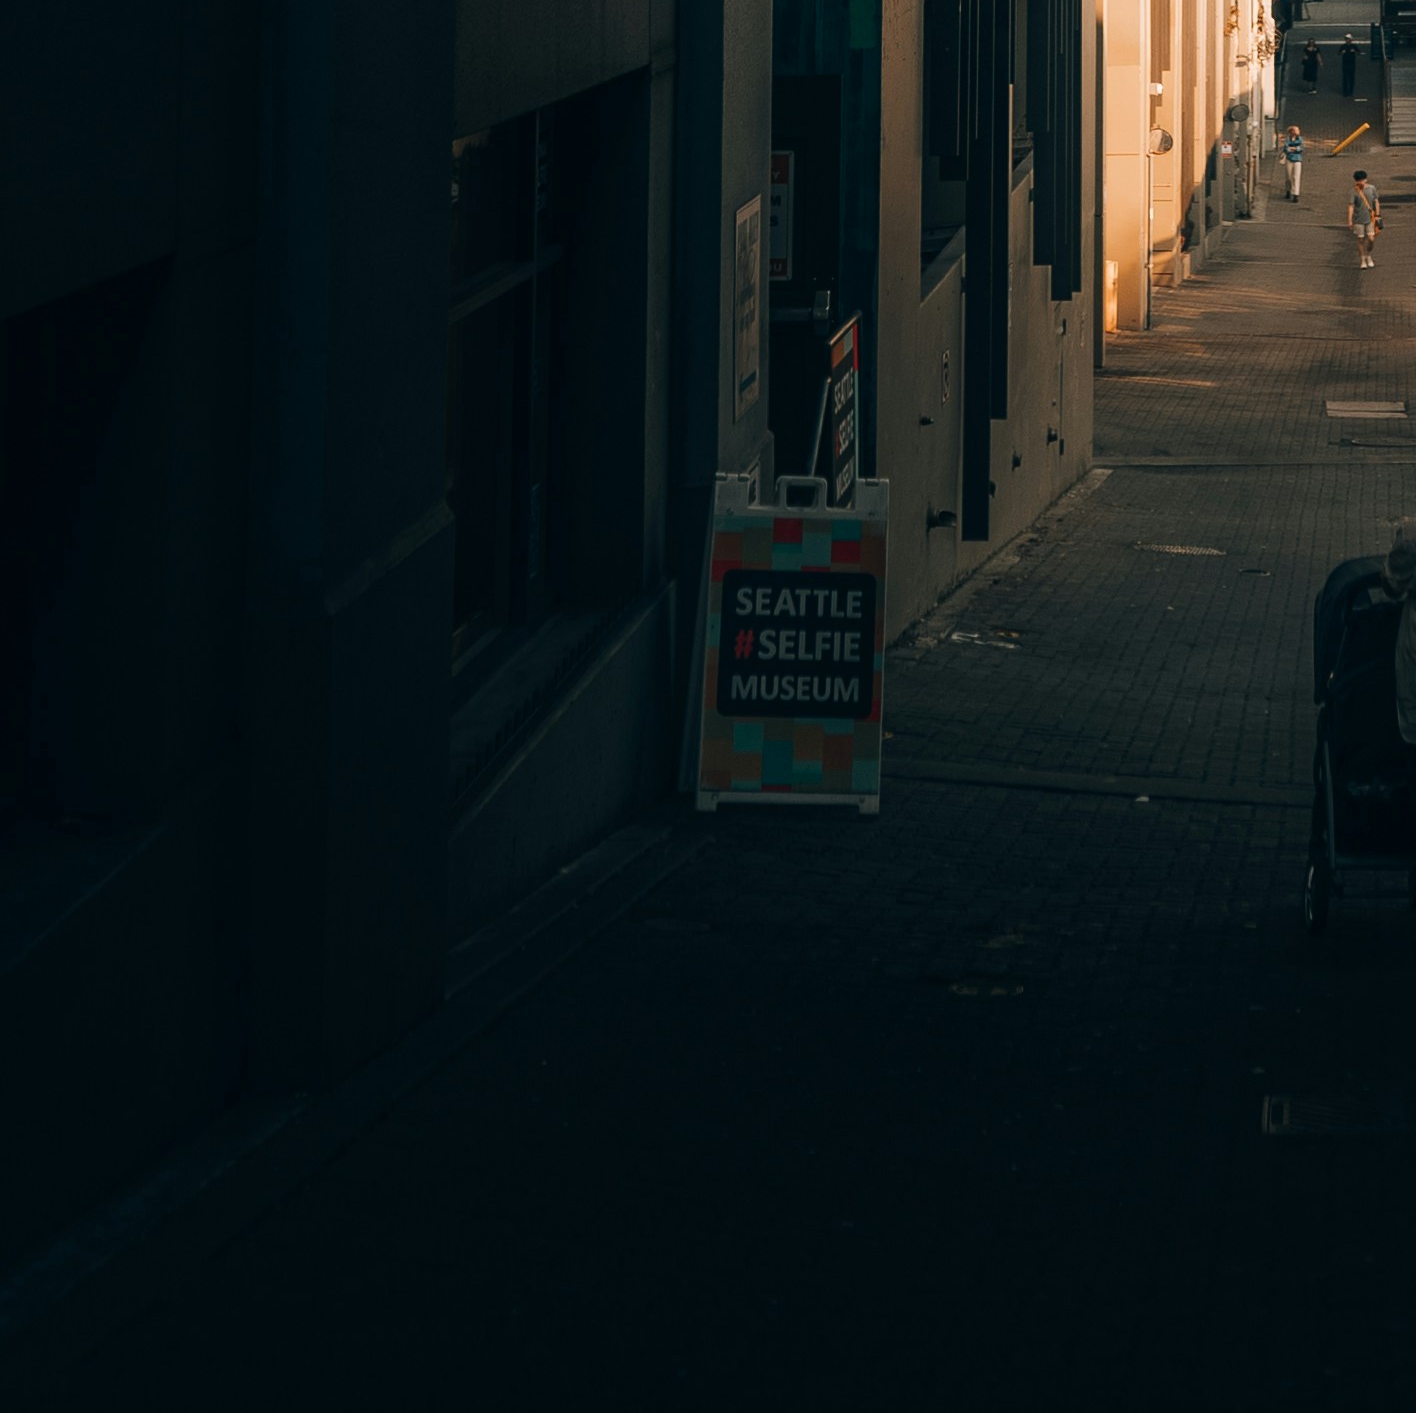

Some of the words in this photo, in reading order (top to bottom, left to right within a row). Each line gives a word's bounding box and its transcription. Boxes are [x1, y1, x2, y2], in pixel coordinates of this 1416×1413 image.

[734, 586, 863, 619] SEATTLE
[733, 628, 862, 662] #SELFIE
[730, 674, 860, 703] MUSEUM
